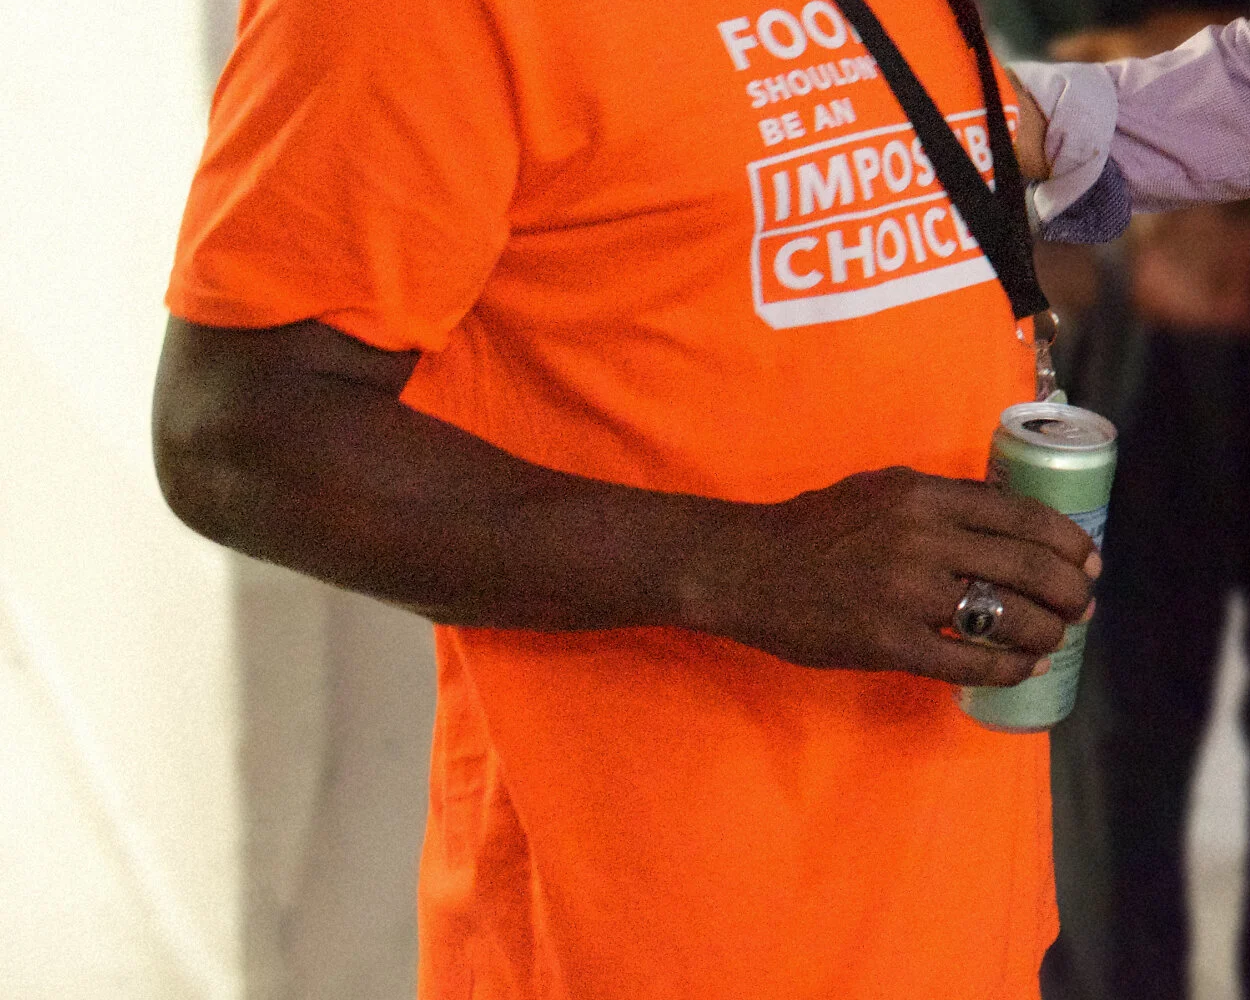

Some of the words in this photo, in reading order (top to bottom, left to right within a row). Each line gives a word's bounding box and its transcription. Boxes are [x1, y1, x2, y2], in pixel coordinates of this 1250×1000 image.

[717, 0, 863, 71] FOO
[746, 54, 878, 109] SHOULDN
[758, 111, 806, 147] BE
[814, 97, 857, 133] AN
[772, 119, 1016, 223] IMPOSB
